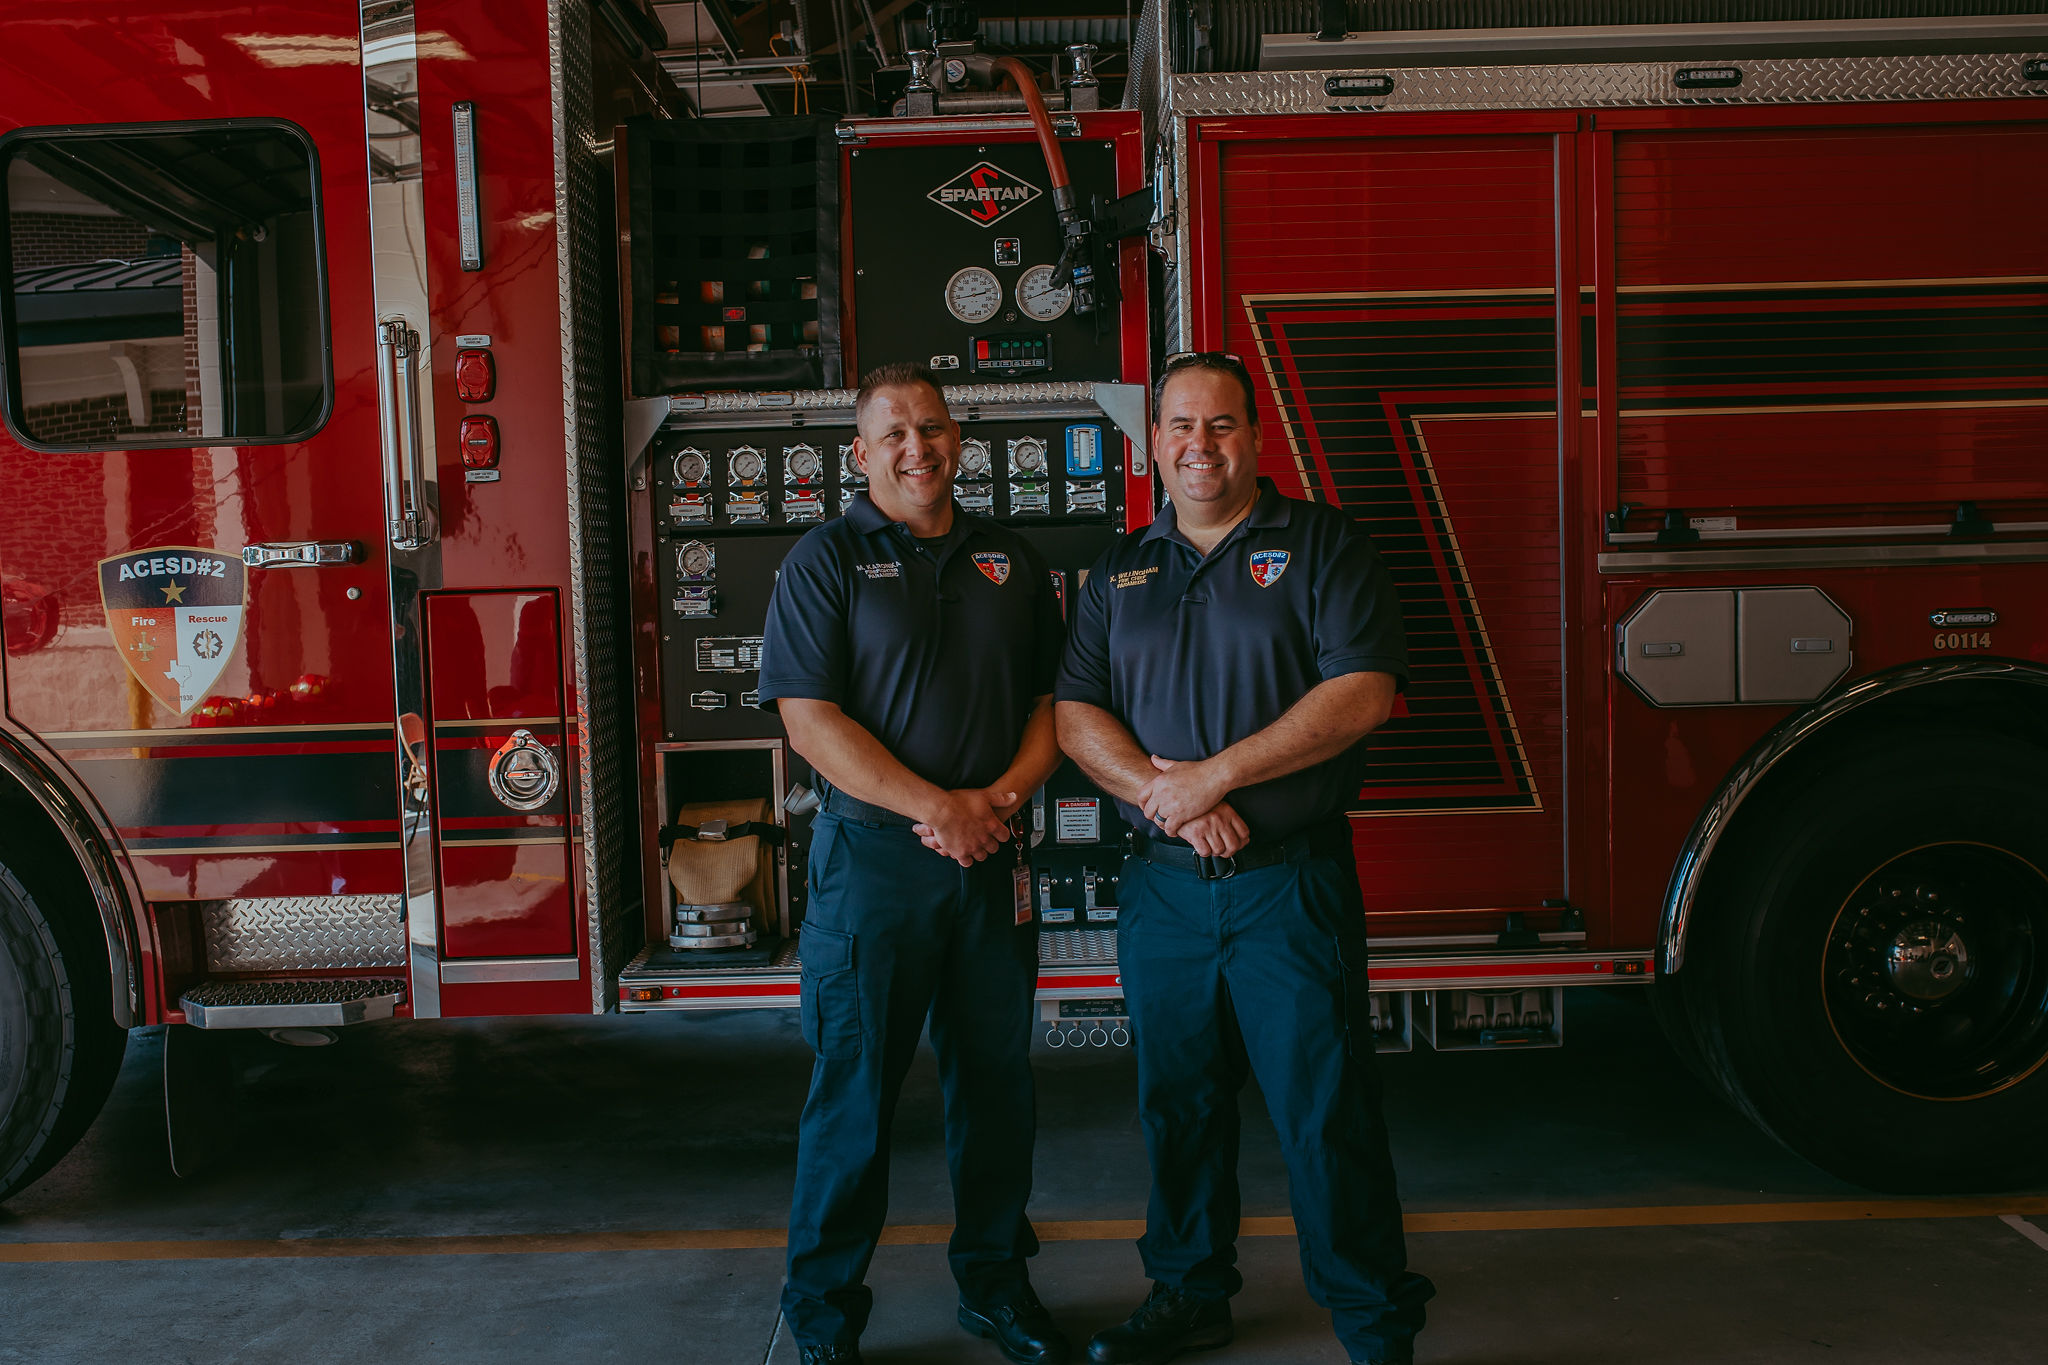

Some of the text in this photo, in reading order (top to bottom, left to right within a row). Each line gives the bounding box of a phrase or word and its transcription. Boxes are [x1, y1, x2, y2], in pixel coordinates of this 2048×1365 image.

[940, 186, 1029, 202] SPARTAN
[119, 556, 226, 582] ACESD#2
[131, 616, 157, 626] Fire
[188, 615, 228, 623] Rescue
[1934, 632, 1992, 650] 60114
